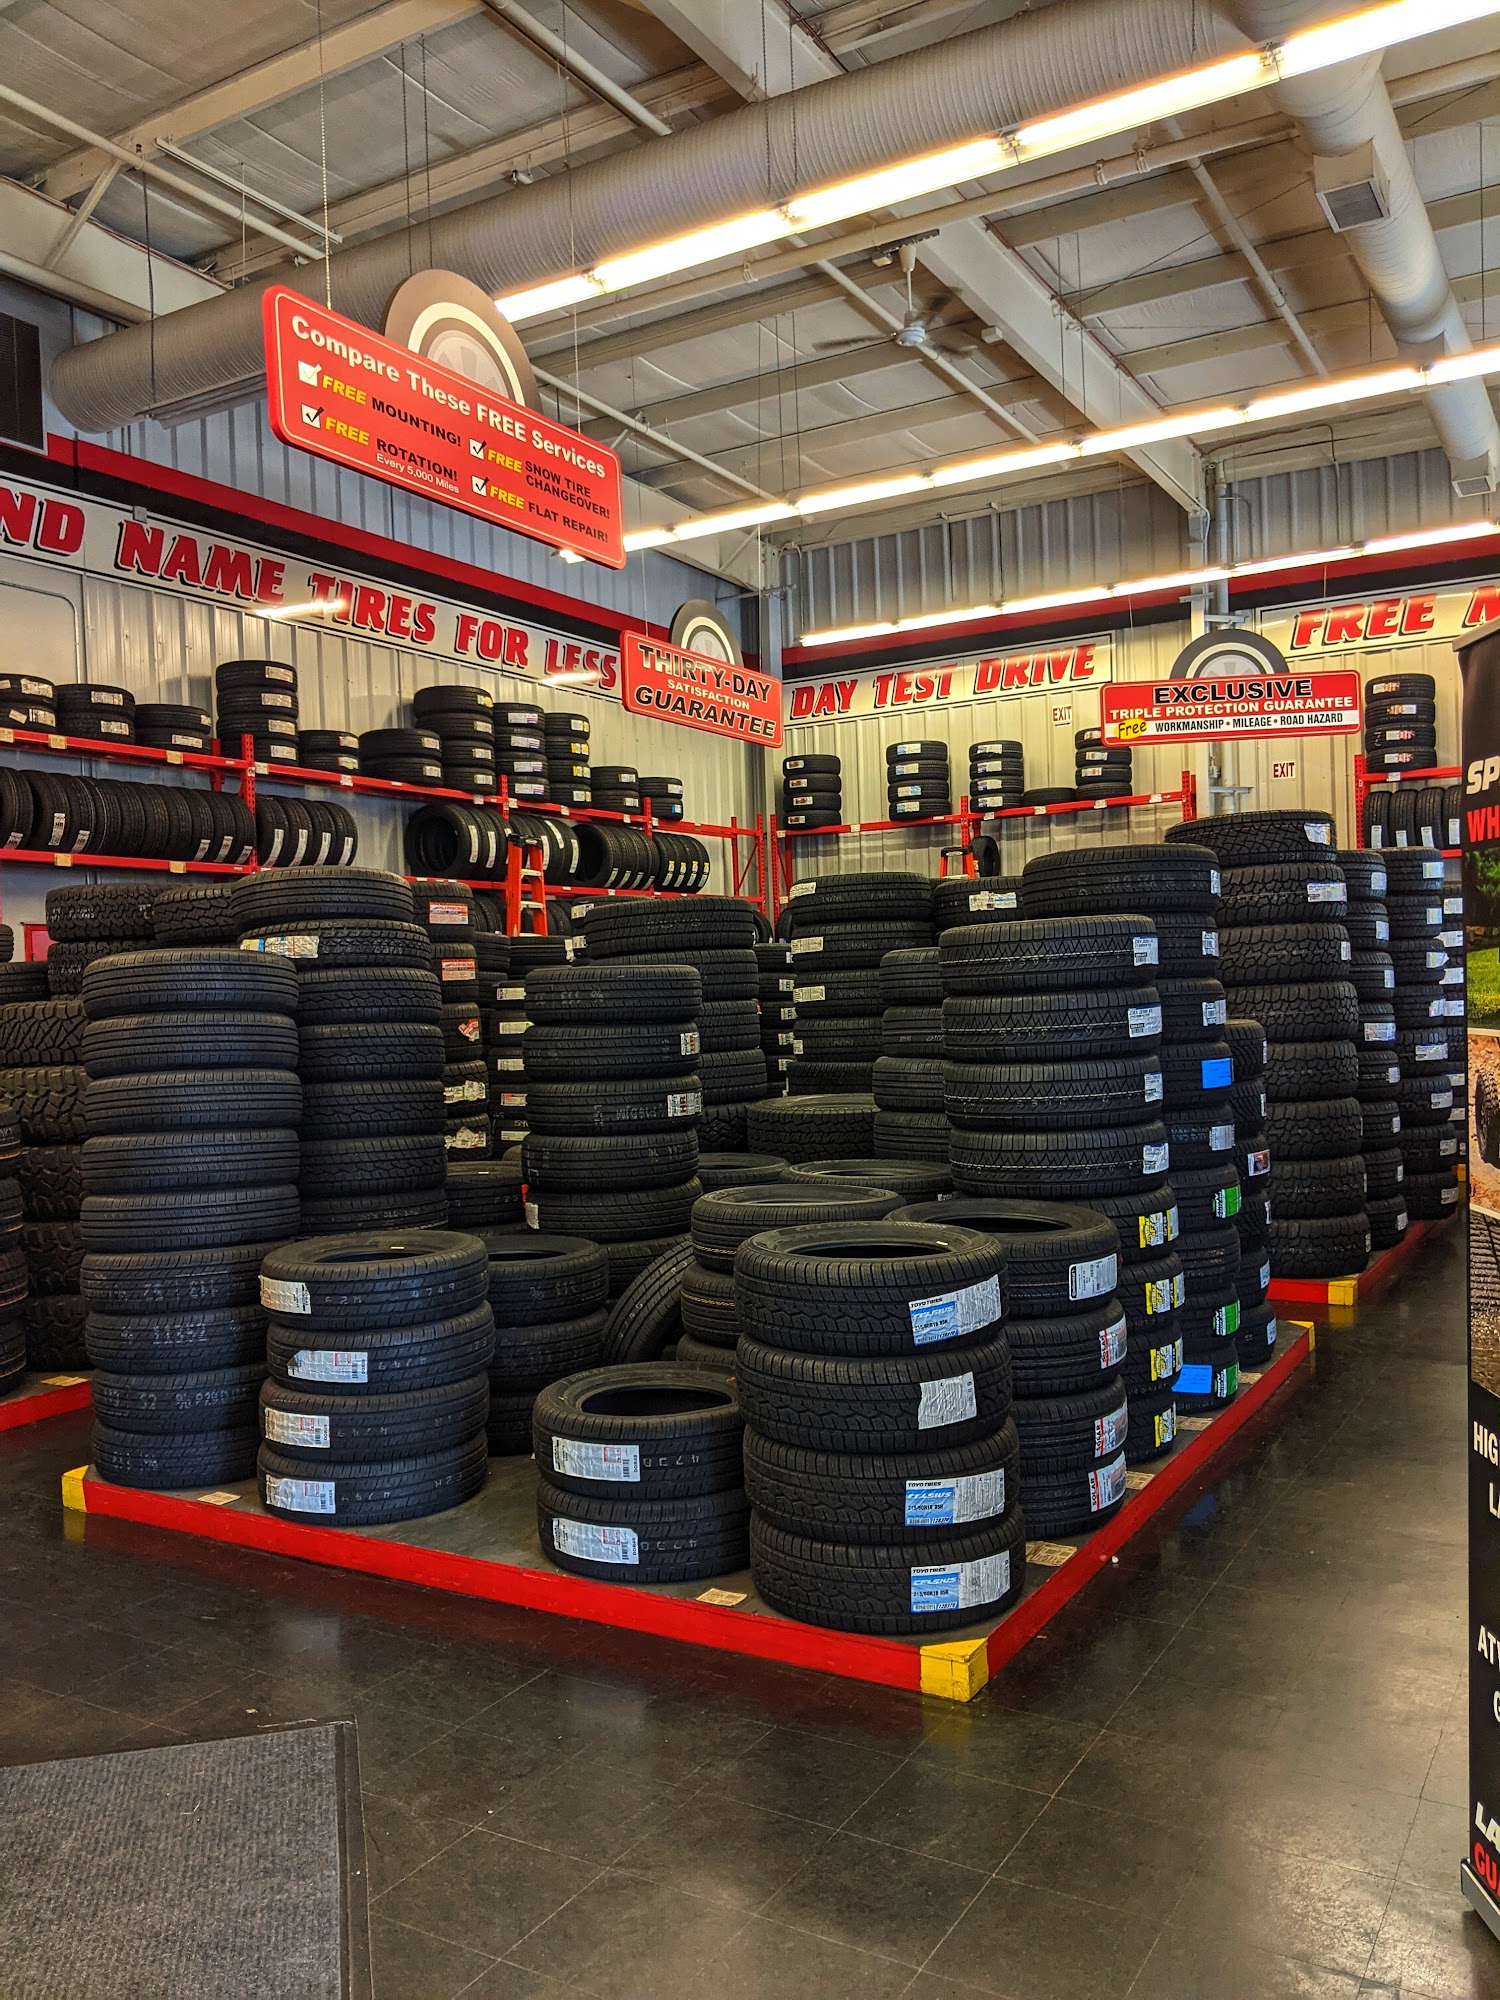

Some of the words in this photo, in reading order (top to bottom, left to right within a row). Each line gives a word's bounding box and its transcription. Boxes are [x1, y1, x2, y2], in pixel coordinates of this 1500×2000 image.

[292, 315, 399, 382] Compare
[405, 369, 471, 415] These
[476, 403, 526, 442] FREE
[531, 429, 605, 478] Services
[322, 375, 367, 405] FREE
[372, 397, 461, 447] MOUNTING!
[324, 416, 369, 446] FREE
[376, 438, 458, 481] ROTATION!
[376, 453, 405, 472] Every
[407, 466, 433, 483] 5,000
[435, 477, 460, 494] Miles
[488, 449, 522, 473] FREE
[525, 461, 561, 485] SNOW
[564, 478, 591, 498] TIRE
[490, 485, 525, 509] FREE
[528, 502, 559, 522] FLAT
[562, 515, 608, 543] REPAIR!
[526, 475, 610, 519] CHANGEOVER!
[114, 519, 286, 605] NAME
[308, 572, 436, 643] TIRES
[454, 613, 529, 668] FOR
[544, 638, 617, 690] LESS
[1290, 593, 1437, 650] FREE
[638, 642, 772, 703] THIRTY-DAY
[667, 679, 750, 711] SATISFACTION
[790, 679, 858, 720] DAY
[874, 663, 958, 708] TEST
[973, 643, 1097, 695] DRIVE
[1153, 678, 1312, 705] EXCLUSIVE
[634, 684, 776, 738] GUARANTEE
[1053, 706, 1072, 721] EXIT
[1110, 707, 1161, 720] TRIPLE
[1166, 702, 1259, 717] PROTECTION
[1264, 697, 1353, 712] GUARANTEE
[1118, 721, 1147, 739] Free
[1155, 719, 1224, 733] WORKMANSHIP
[1232, 716, 1272, 729] MILEAGE
[1280, 714, 1305, 726] ROAD
[1307, 712, 1343, 725] HAZARD
[1273, 762, 1295, 779] EXIT
[907, 1491, 952, 1500] CELSIUS
[913, 1577, 957, 1586] CELSIUS
